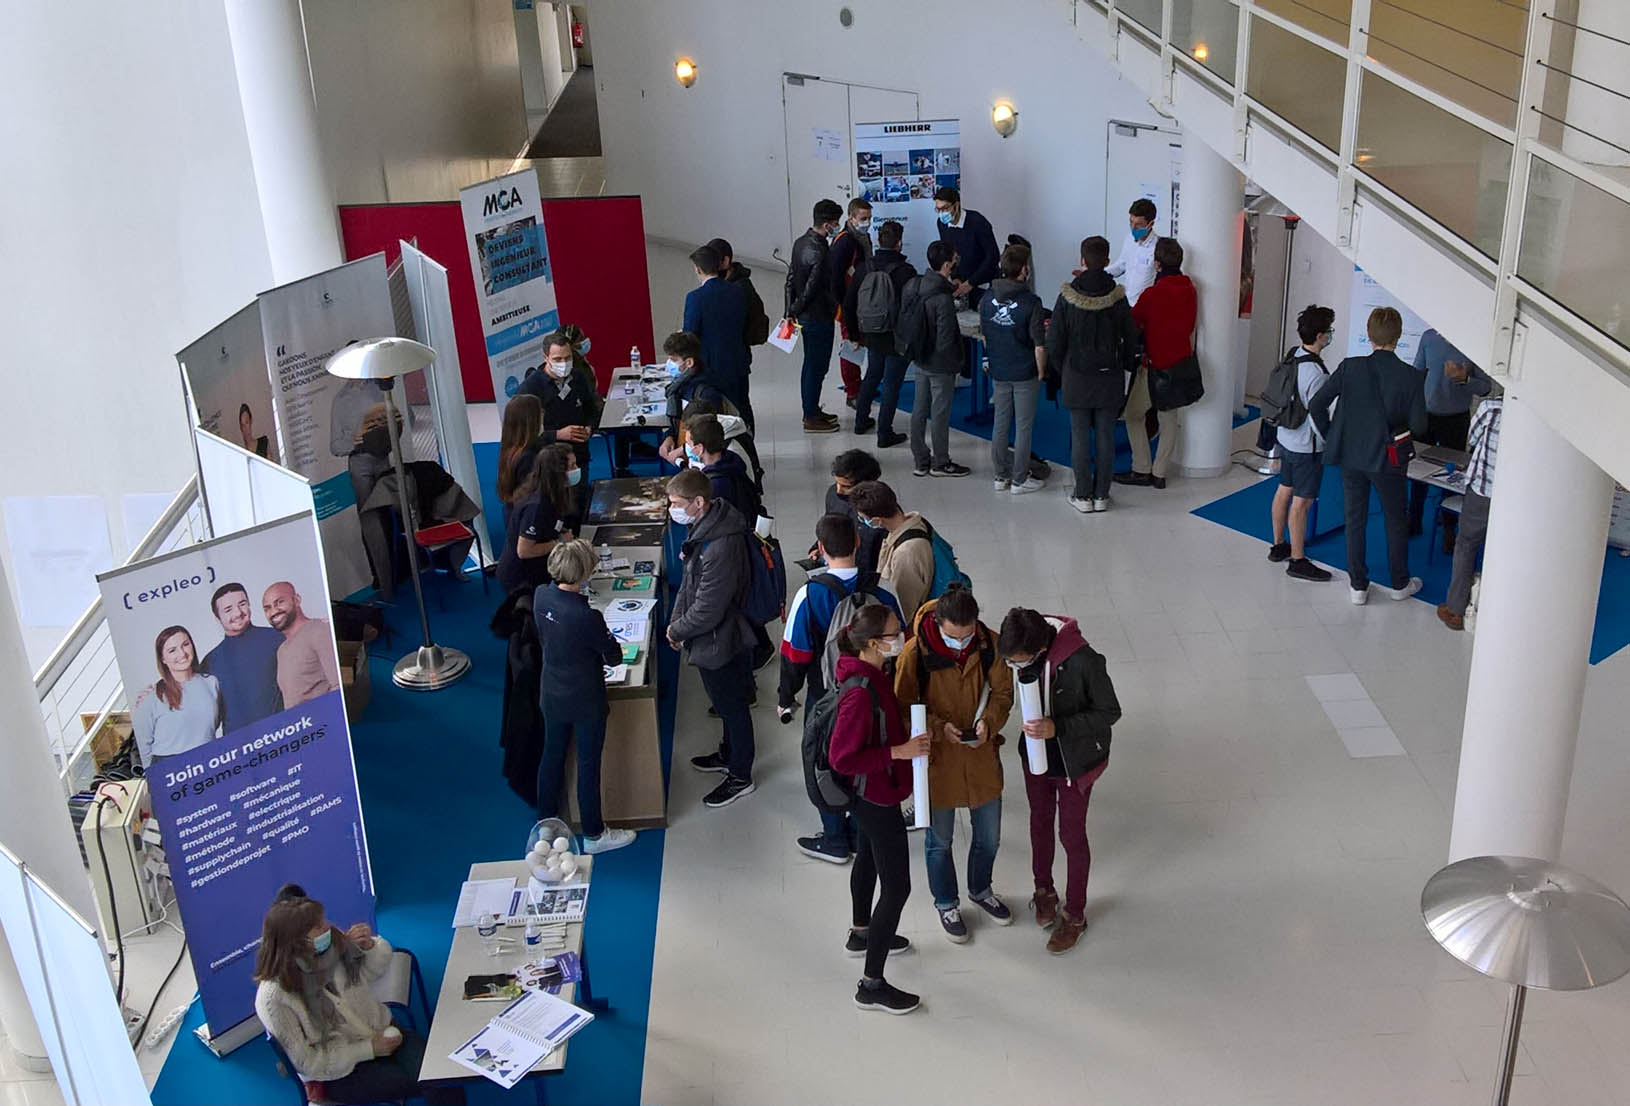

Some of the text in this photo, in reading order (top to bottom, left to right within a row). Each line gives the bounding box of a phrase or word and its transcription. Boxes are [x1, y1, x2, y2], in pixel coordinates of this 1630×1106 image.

[884, 124, 931, 134] LIEBHERR
[483, 186, 523, 217] MCA
[488, 234, 524, 255] DEVIENS
[494, 257, 547, 284] CONSULTANT
[491, 304, 531, 327] AMBITIEUSE
[138, 575, 202, 603] expleo
[165, 716, 313, 787] Join our network
[171, 727, 327, 802] of game-changers
[176, 763, 303, 826] #system #software #IT
[179, 779, 301, 838] #hardware #mécanique
[182, 792, 301, 851] #matériaux #electrique
[185, 793, 325, 864] #méthode #industrialisation
[188, 796, 342, 876] #supplychain #qualité #RAMS
[191, 825, 309, 888] #gestiondeprojet #PMO
